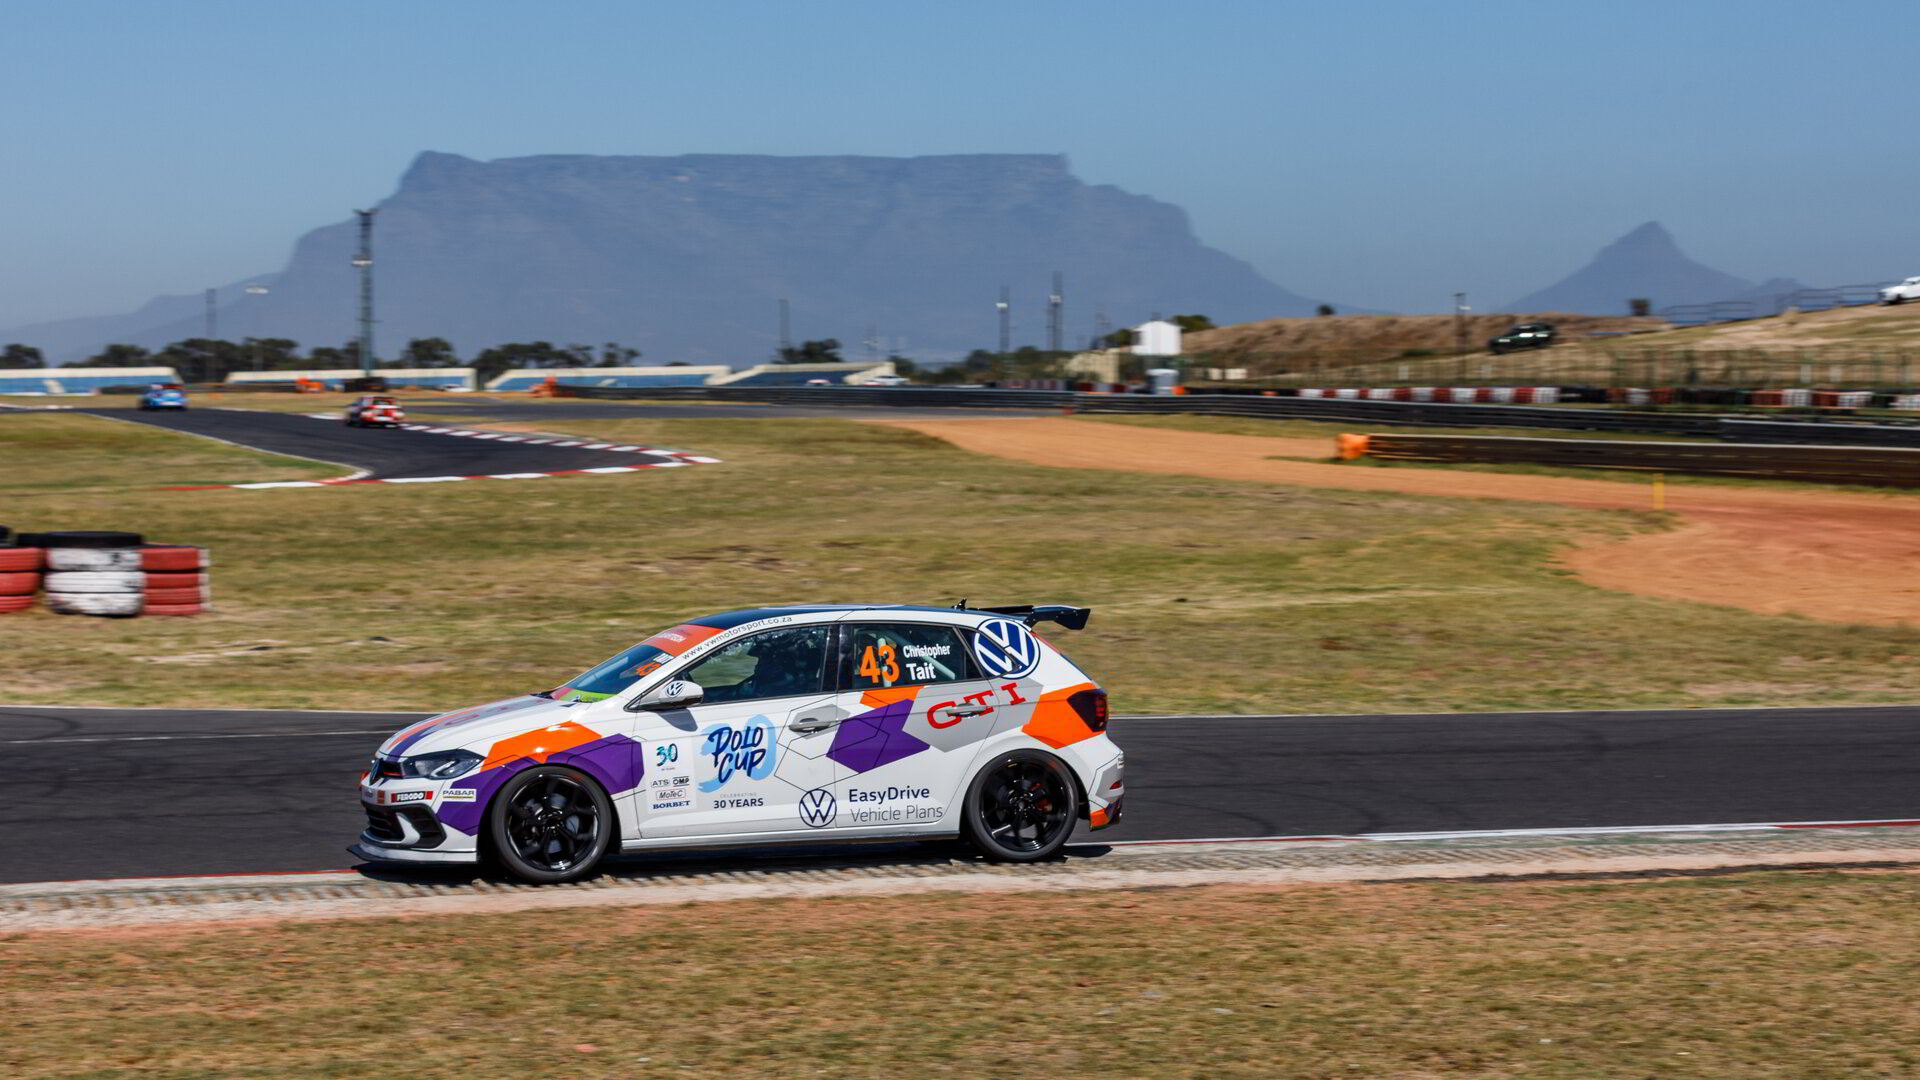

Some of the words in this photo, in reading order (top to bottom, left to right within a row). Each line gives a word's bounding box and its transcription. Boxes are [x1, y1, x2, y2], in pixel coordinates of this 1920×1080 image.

[682, 616, 793, 660] www.vwmotorsport.co.za
[903, 643, 950, 658] Christopher
[860, 645, 900, 683] 43
[906, 662, 936, 680] Tait
[927, 682, 1026, 729] GTI
[656, 743, 678, 767] 30
[718, 748, 766, 783] CUP
[396, 792, 425, 802] FERODO
[442, 789, 475, 797] PABAR
[849, 785, 930, 805] EasyDrive
[652, 800, 690, 810] BORBET
[713, 799, 727, 809] 30
[728, 797, 764, 808] YEARS
[850, 807, 901, 822] Vehicle
[906, 804, 943, 819] Plans
